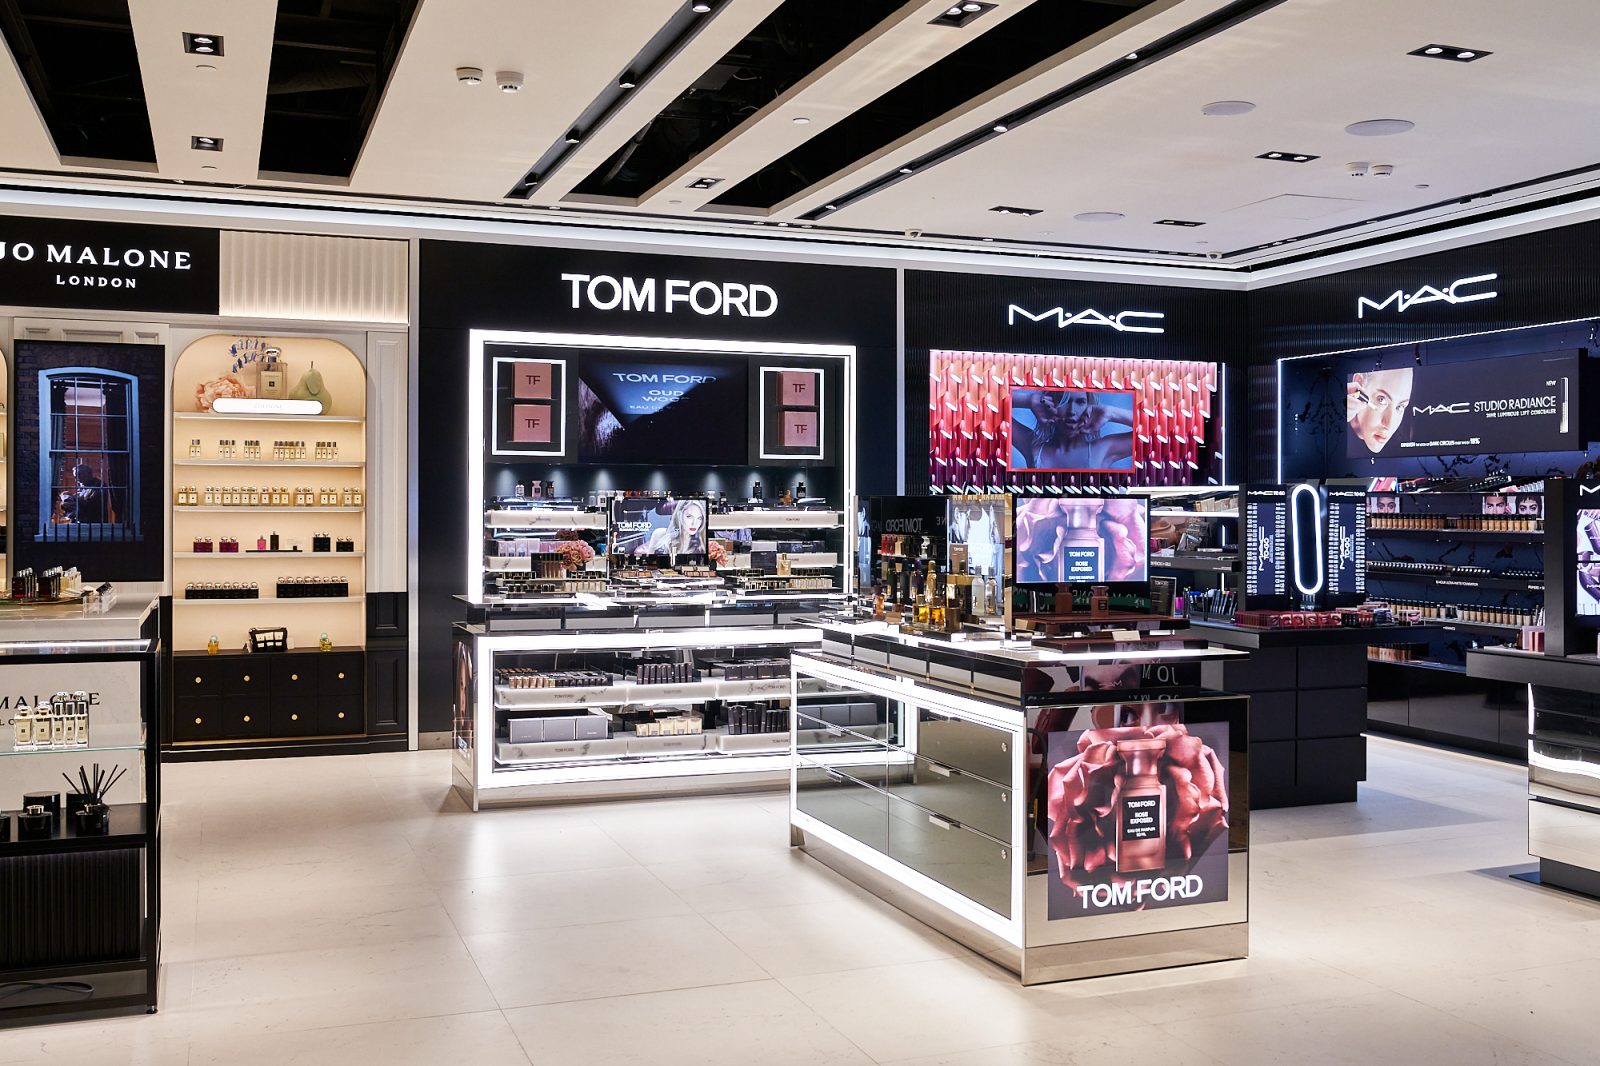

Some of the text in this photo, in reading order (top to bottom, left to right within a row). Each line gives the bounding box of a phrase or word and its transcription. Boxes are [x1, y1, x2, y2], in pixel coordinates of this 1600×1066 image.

[0, 241, 191, 270] JO MALONE
[56, 274, 136, 289] LONDON
[561, 273, 778, 318] TOM FORD
[525, 374, 541, 385] TF
[612, 373, 658, 383] TOM
[648, 389, 685, 397] OUD
[792, 383, 806, 393] TF
[1474, 399, 1508, 413] STUDIO
[1508, 395, 1557, 410] RADIANCE
[525, 418, 540, 428] TF
[794, 424, 808, 434] TF
[617, 521, 652, 529] TOM FORD
[1077, 874, 1203, 909] TOM FORD
